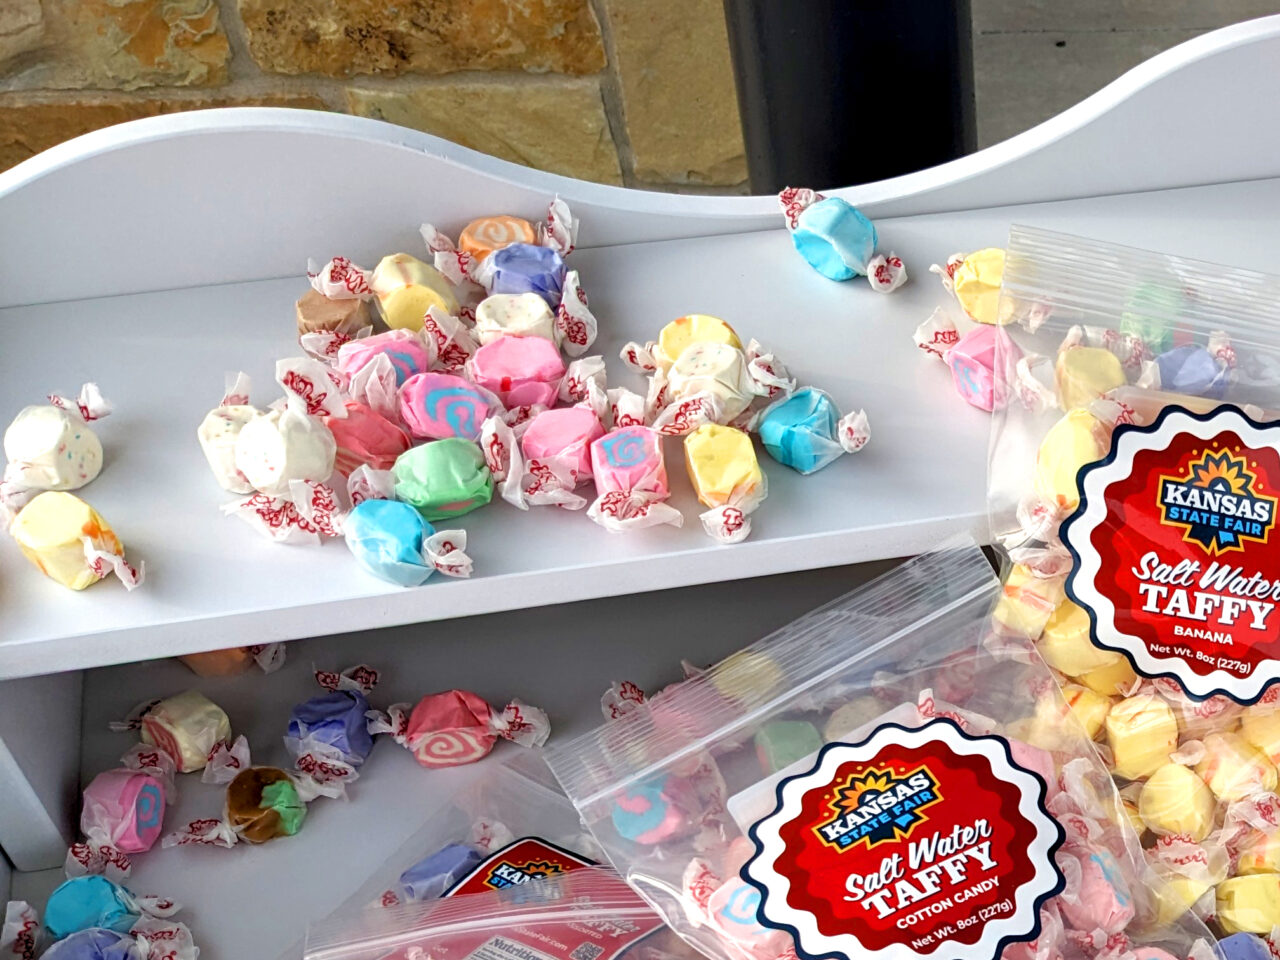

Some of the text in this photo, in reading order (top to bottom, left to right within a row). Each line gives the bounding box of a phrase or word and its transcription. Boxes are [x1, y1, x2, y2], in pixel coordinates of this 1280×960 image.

[1163, 482, 1271, 522] KANSAS
[1169, 506, 1262, 536] STATE FAIR
[1131, 551, 1201, 587] Salt
[1139, 583, 1274, 630] TAFFY
[1149, 643, 1251, 675] Net Wt. 8oz (227g)
[1174, 625, 1233, 645] BANANA
[820, 773, 931, 841] KANSAS
[839, 790, 934, 847] STATE FAIR
[843, 818, 992, 902] Salt Water
[860, 841, 998, 921] TAFFY
[896, 876, 1001, 930] COTTON CANDY
[911, 899, 1013, 950] Net Wt. 8oz (227g)
